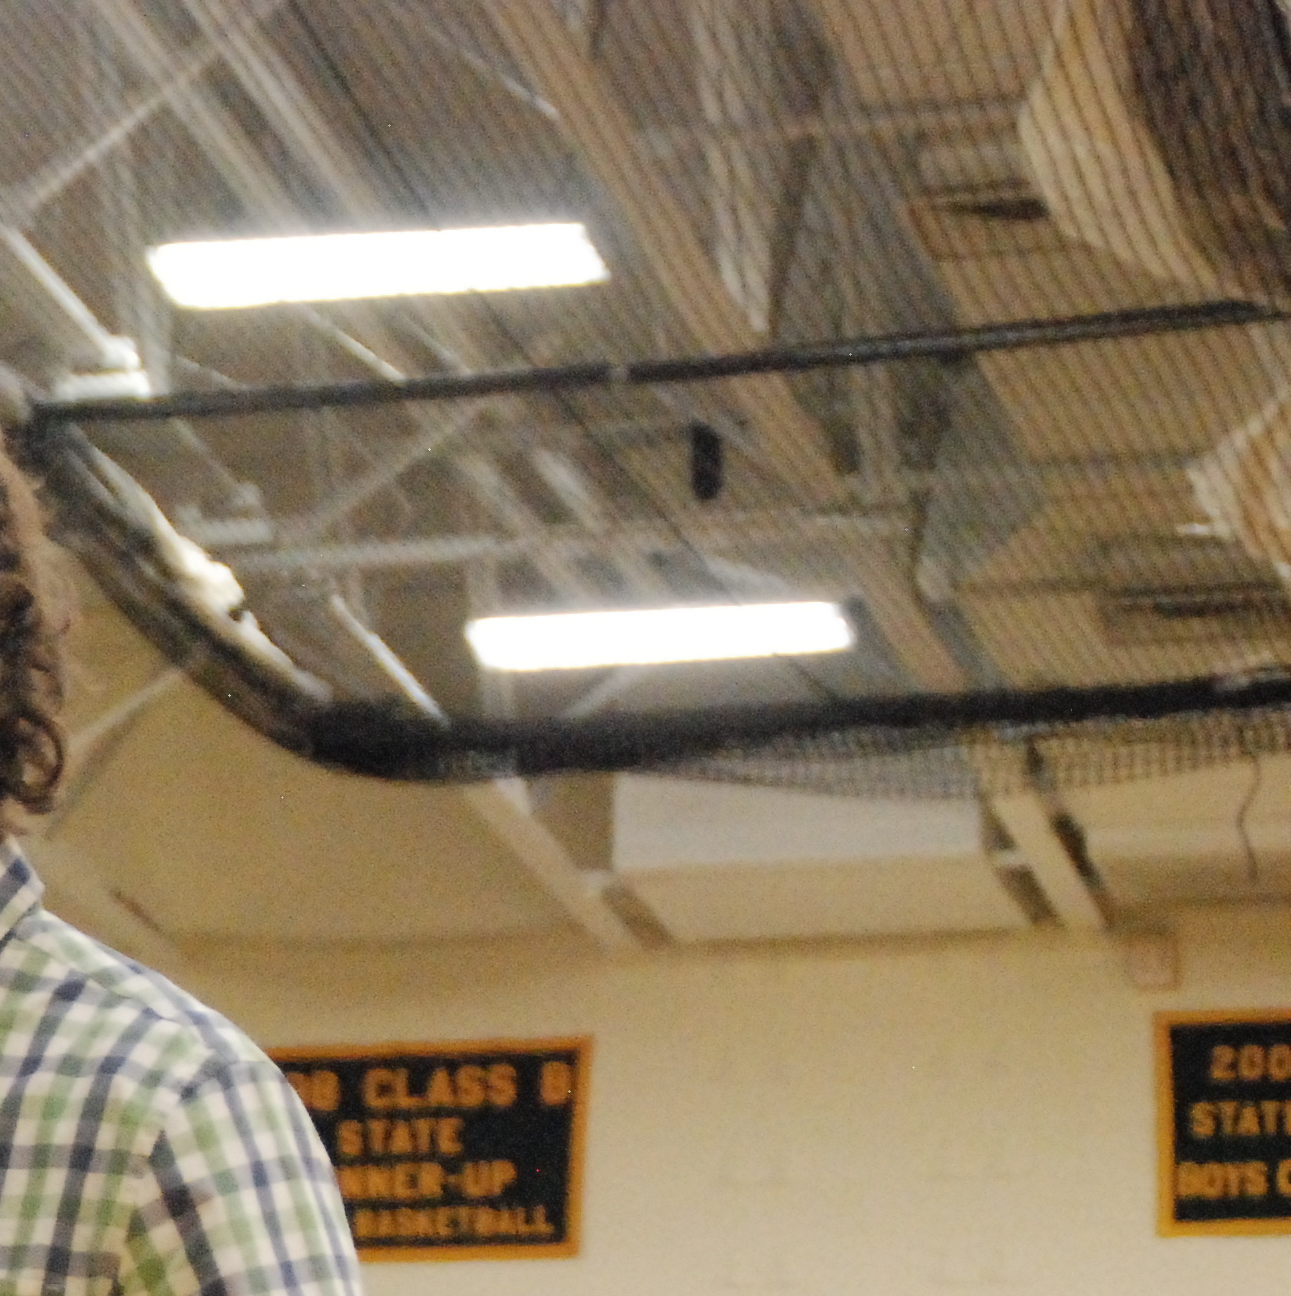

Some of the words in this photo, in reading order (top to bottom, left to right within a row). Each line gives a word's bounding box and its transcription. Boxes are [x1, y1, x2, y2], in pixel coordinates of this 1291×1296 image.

[363, 1062, 518, 1110] CLASS
[335, 1116, 464, 1156] STATE
[352, 1203, 555, 1238] BASKETBALL
